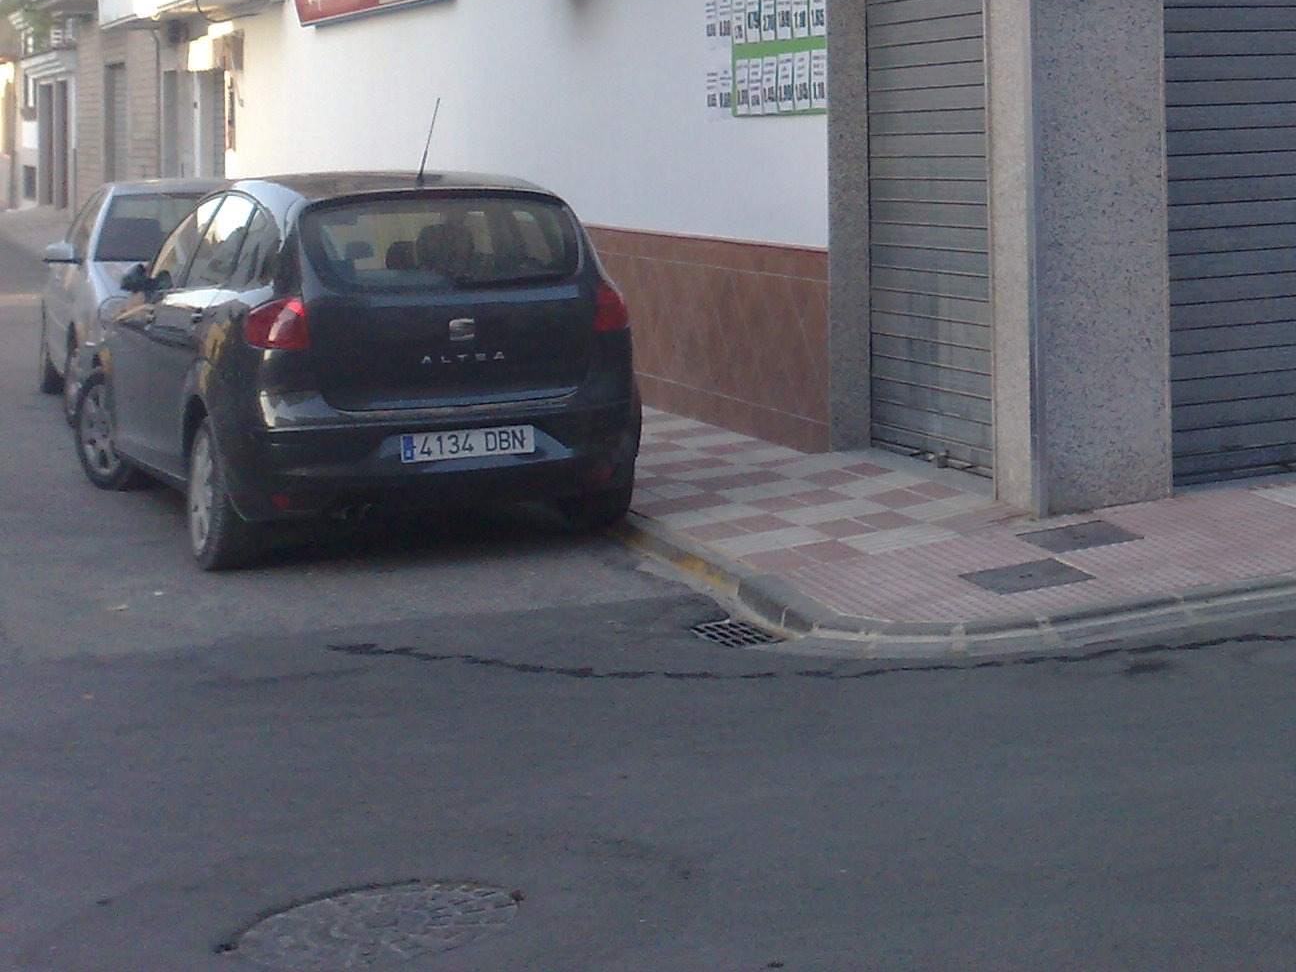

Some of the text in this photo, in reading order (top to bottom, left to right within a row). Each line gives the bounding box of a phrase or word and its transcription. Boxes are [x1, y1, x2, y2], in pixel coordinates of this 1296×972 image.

[422, 351, 505, 365] ALTEA
[420, 428, 526, 456] 4134 DBN
